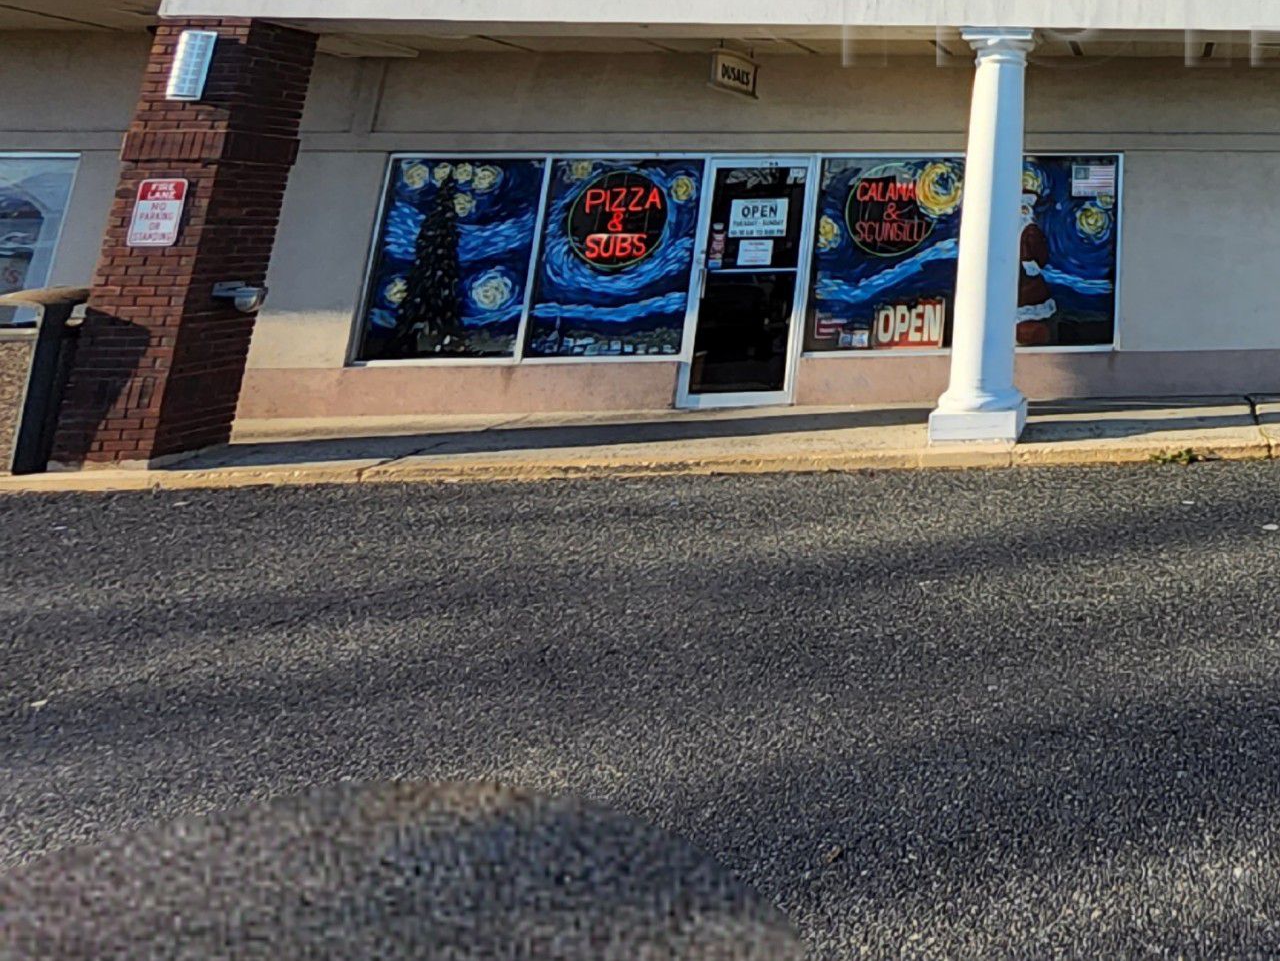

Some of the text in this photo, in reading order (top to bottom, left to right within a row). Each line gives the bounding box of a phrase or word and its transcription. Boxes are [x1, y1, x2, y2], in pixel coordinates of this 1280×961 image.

[147, 191, 176, 199] LANE
[585, 188, 662, 214] PIZZA
[856, 181, 918, 202] CALAMA
[151, 202, 167, 211] NO
[741, 205, 778, 218] OPEN
[883, 202, 898, 221] &
[607, 211, 623, 233] &
[585, 233, 647, 258] SUBS
[877, 304, 942, 343] OPEN
